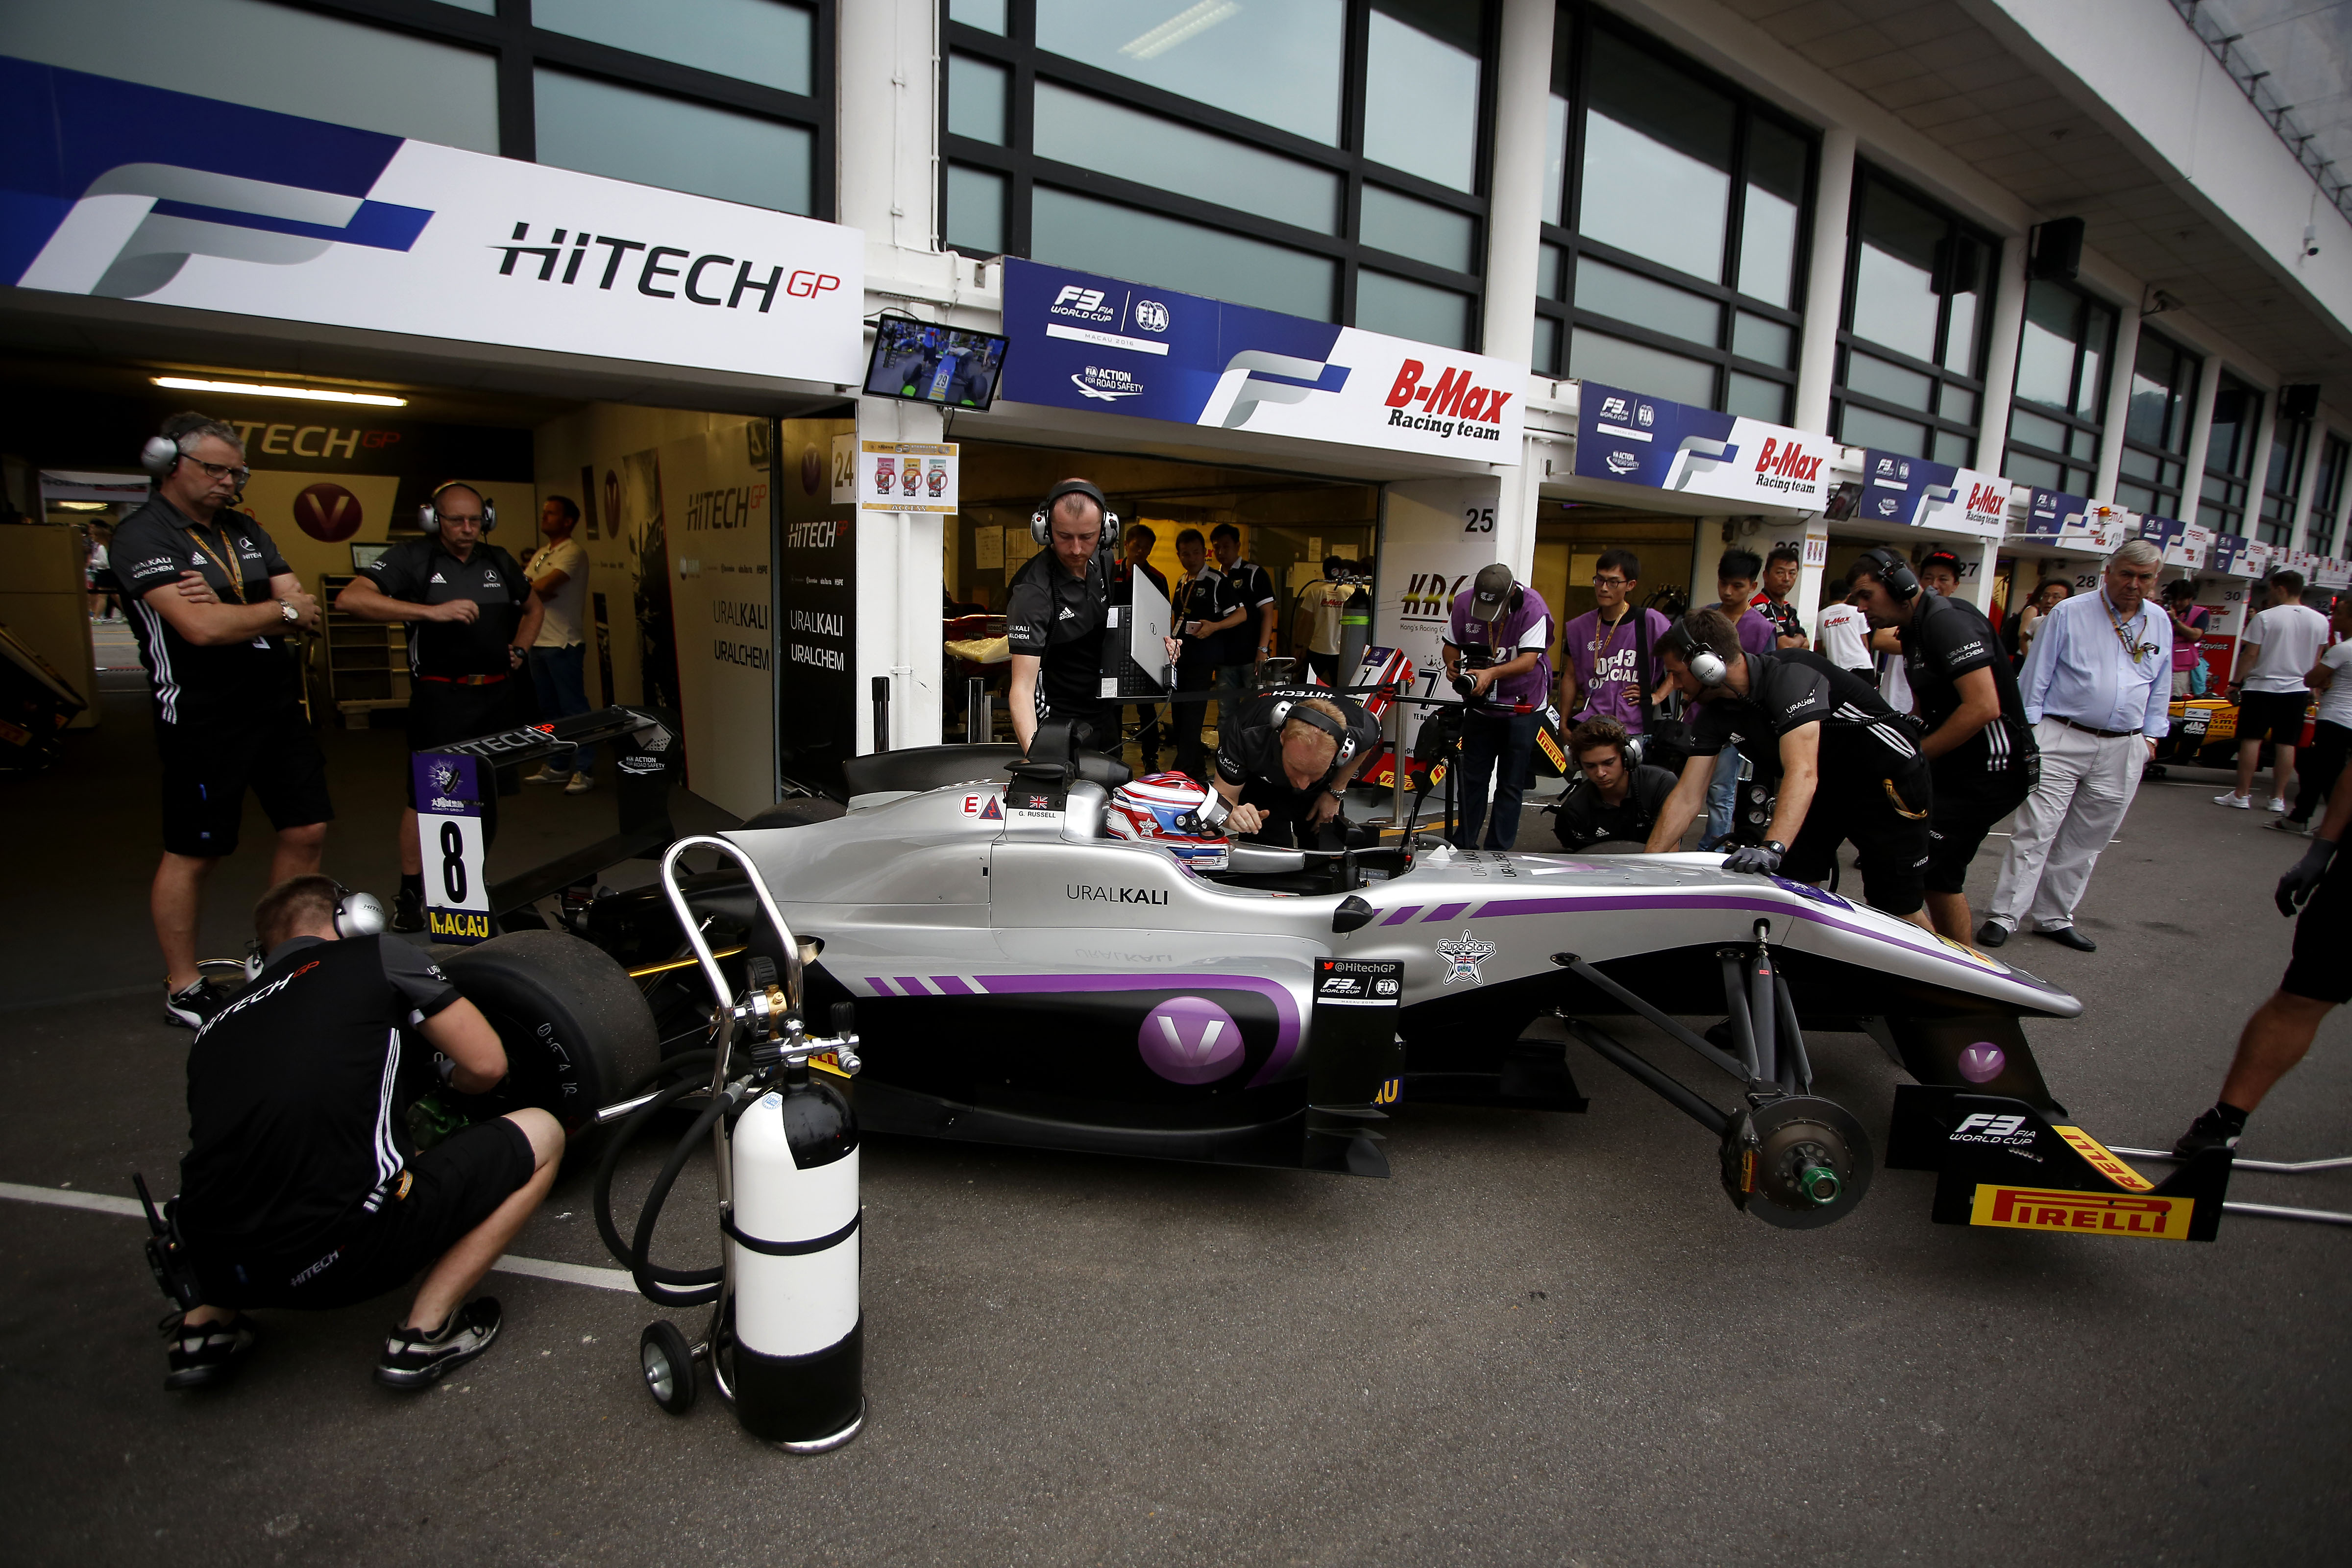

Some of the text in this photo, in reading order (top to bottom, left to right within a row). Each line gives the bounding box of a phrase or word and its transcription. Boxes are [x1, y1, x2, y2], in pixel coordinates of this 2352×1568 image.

[786, 270, 840, 298] GP
[1054, 285, 1105, 312] F3
[1051, 306, 1112, 322] WORLD CUP
[1098, 306, 1114, 315] FIA
[1085, 333, 1113, 343] MACAU
[1099, 368, 1131, 382] ACTION
[1097, 379, 1116, 389] ROAD
[1117, 382, 1144, 392] SAFETY
[1385, 358, 1514, 424] B-Max
[1602, 397, 1626, 414] F3
[1388, 409, 1500, 441] Racing team
[363, 431, 400, 448] GP
[834, 451, 853, 487] 24
[1755, 438, 1823, 481] B-Max
[1756, 474, 1815, 493] Racing team
[751, 484, 766, 509] GP
[1966, 483, 2005, 515] B-Max
[1465, 508, 1494, 533] 25
[1966, 511, 1999, 525] Racing team
[836, 520, 848, 536] GP
[1960, 563, 1979, 577] 27
[2076, 575, 2096, 588] 28
[2224, 591, 2240, 601] 30
[713, 600, 768, 630] URALKALI
[790, 610, 843, 637] URALKALI
[1059, 612, 1075, 620] adidas
[1400, 623, 1437, 633] Kang's Racing
[714, 639, 769, 671] URALCHEM
[791, 643, 844, 671] URALCHEM
[1537, 730, 1566, 769] PIRELLI
[964, 797, 979, 813] E
[441, 820, 467, 904] 8
[1067, 884, 1169, 906] URALKALI
[430, 911, 489, 937] MACAU
[1441, 942, 1492, 953] SuperStars
[293, 961, 319, 978] GP
[1335, 962, 1396, 972] @HitechGP
[1323, 978, 1356, 989] F3
[1954, 1113, 2027, 1136] F3
[1949, 1133, 2033, 1146] WORLD CUP
[2062, 1134, 2146, 1189] RELLI
[1992, 1188, 2173, 1233] PIRELLI
